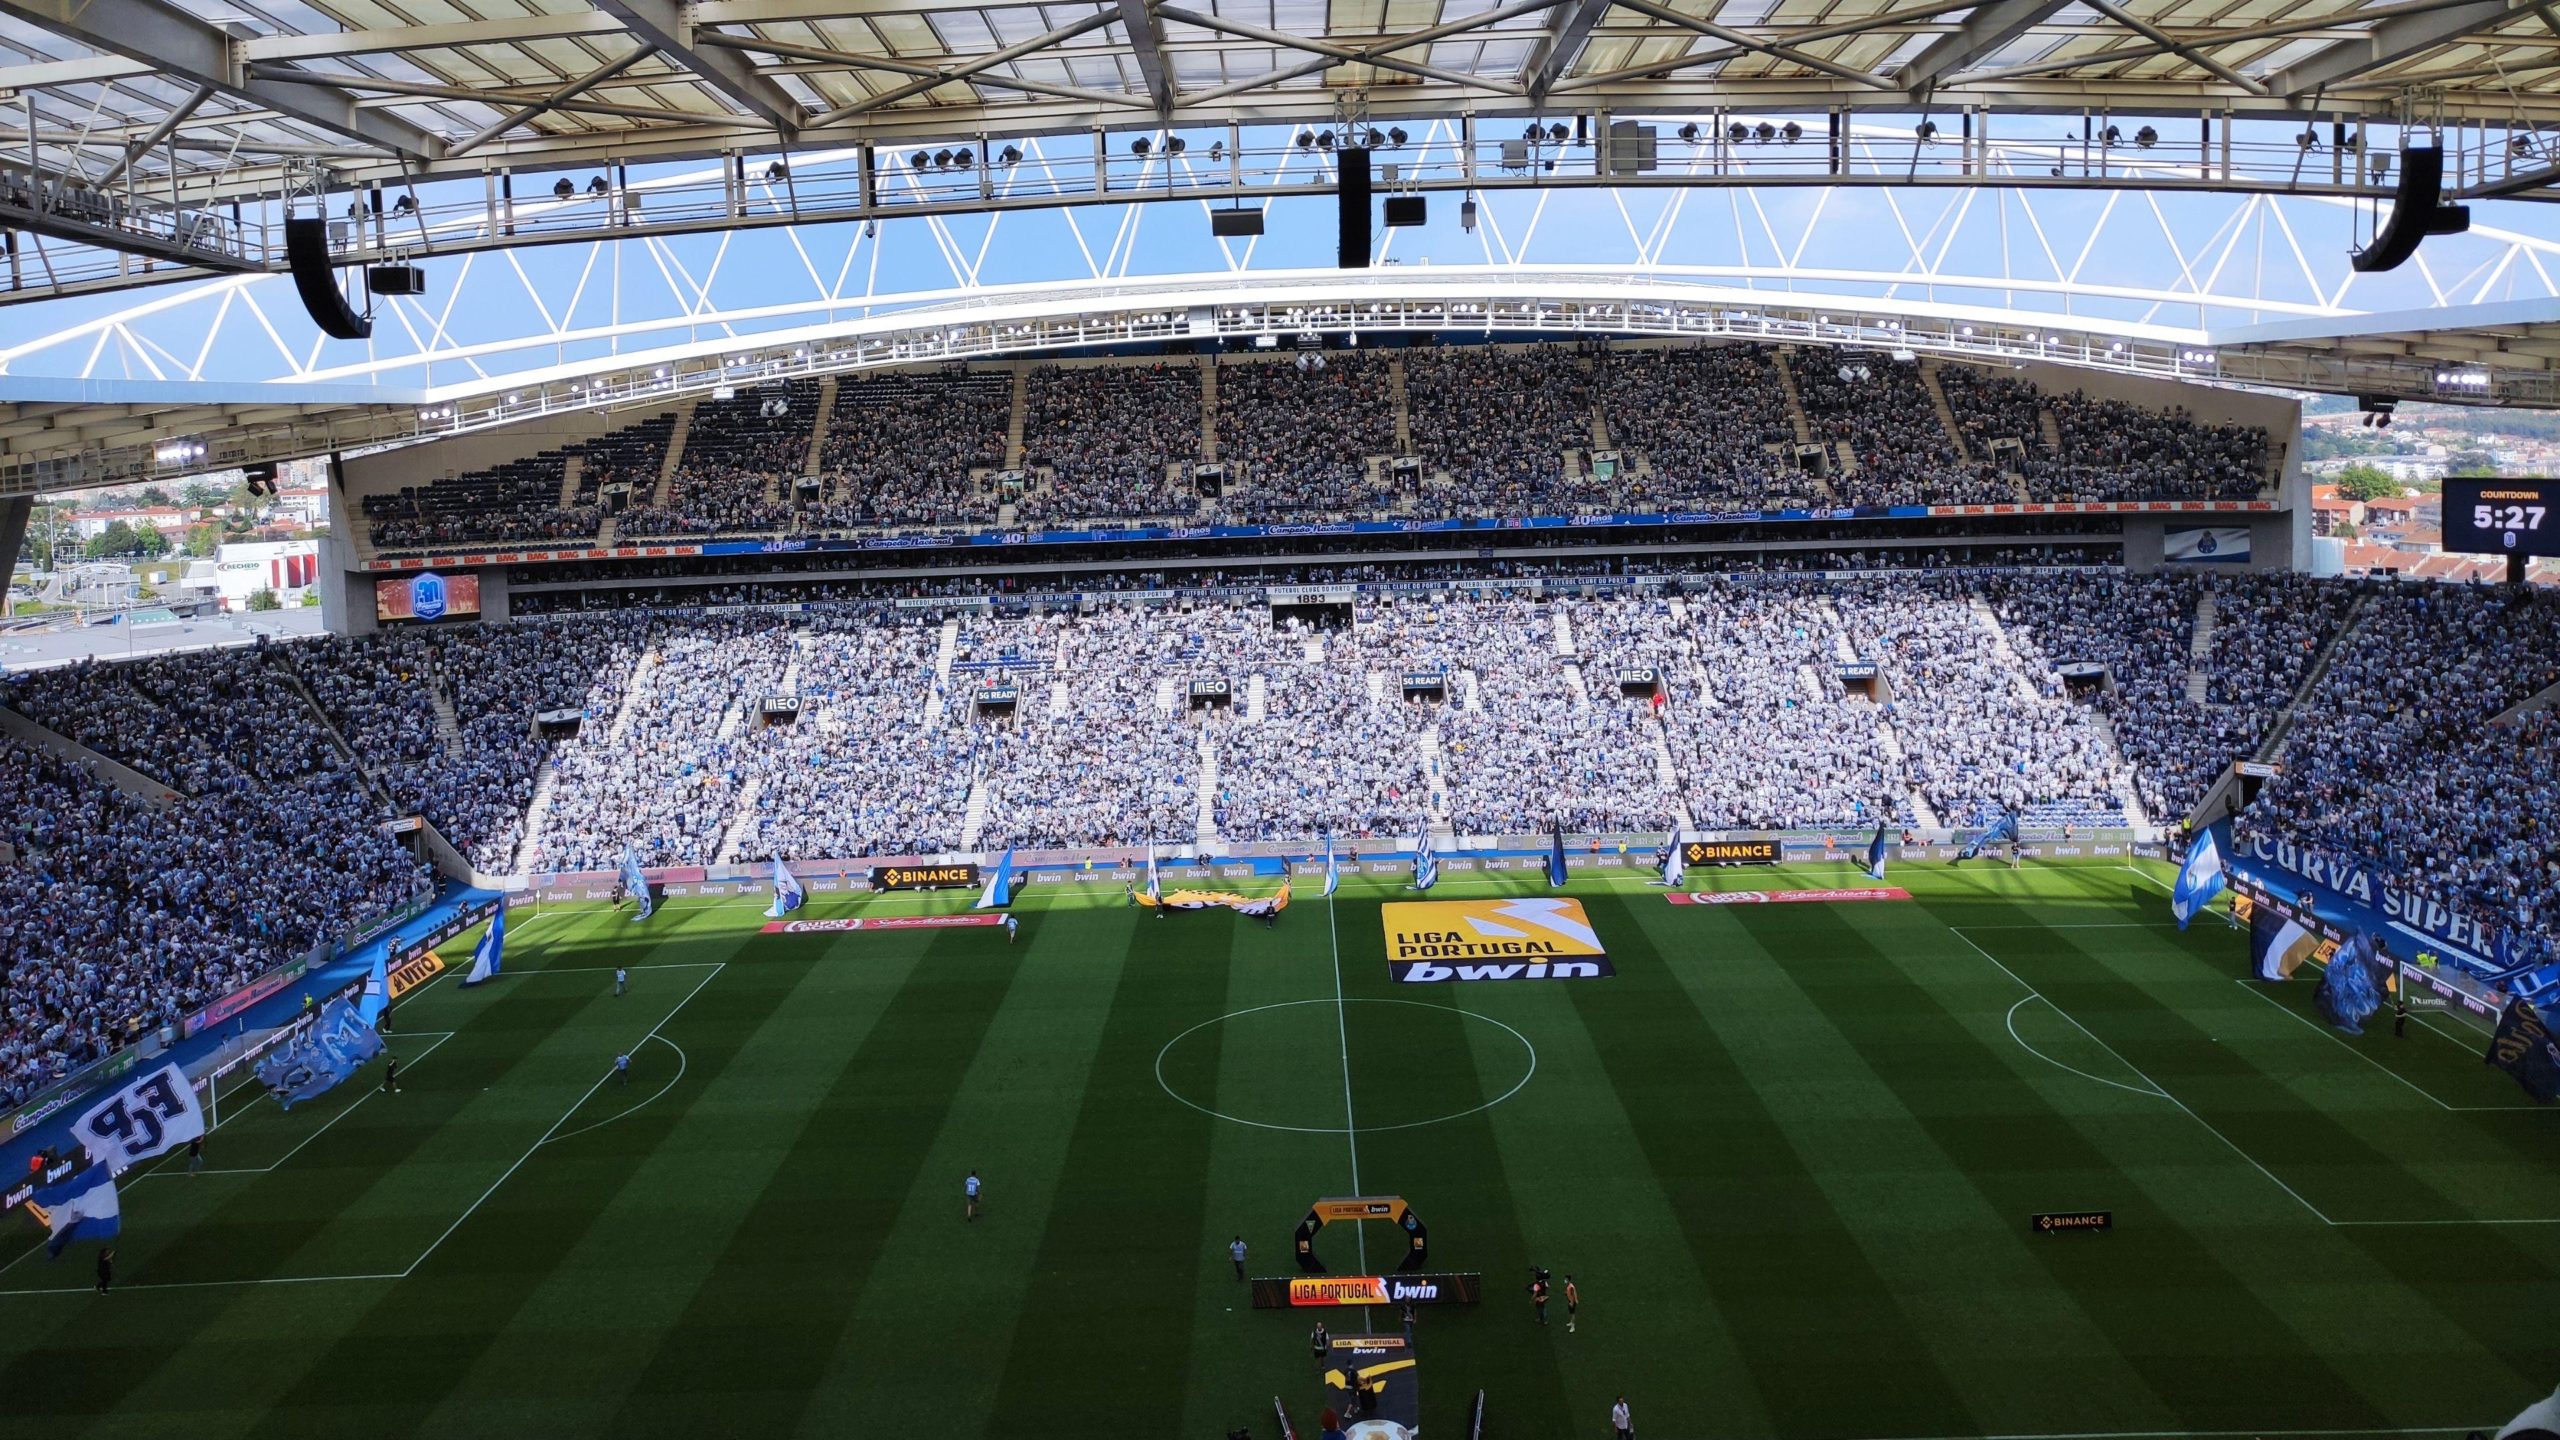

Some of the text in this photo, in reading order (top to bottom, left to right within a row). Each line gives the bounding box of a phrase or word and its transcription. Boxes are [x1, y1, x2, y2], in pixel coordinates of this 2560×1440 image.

[2480, 491, 2539, 500] COUNTDOWN
[1935, 506, 1956, 514] BMG
[1964, 505, 1985, 513] BMG
[1993, 504, 2015, 513] BMG
[2023, 504, 2045, 512] BMG
[2054, 503, 2076, 511] BMG
[2085, 503, 2107, 511] BMG
[2117, 502, 2139, 510] BMG
[2148, 502, 2171, 510] BMG
[2181, 502, 2205, 510] BMG
[2214, 502, 2238, 510] BMG
[2247, 502, 2271, 510] BMG
[1717, 510, 1761, 521] Nacional
[1811, 508, 1830, 518] 40
[2473, 505, 2546, 530] 5:27
[1402, 520, 1421, 530] 40
[1571, 515, 1590, 525] 40
[1312, 522, 1354, 533] Nacional
[909, 535, 953, 546] Nacional
[557, 551, 579, 559] BMG
[587, 550, 608, 558] BMG
[617, 548, 638, 556] BMG
[646, 547, 667, 555] BMG
[675, 546, 695, 554] BMG
[433, 557, 455, 567] BMG
[464, 555, 486, 565] BMG
[496, 554, 518, 563] BMG
[527, 553, 549, 561] BMG
[226, 562, 260, 570] RECHEIO
[369, 560, 392, 570] BMG
[401, 558, 423, 568] BMG
[1296, 594, 1326, 604] 1893
[1620, 669, 1653, 682] MEO
[1835, 666, 1876, 675] 5G READY
[1403, 676, 1442, 685] 5G READY
[1194, 681, 1227, 693] MEO
[978, 690, 1018, 700] 5G READY
[765, 697, 799, 710] MEO
[1706, 845, 1772, 858] BINANCE
[1901, 849, 1926, 858] bwin
[1977, 847, 2003, 857] bwin
[2055, 846, 2080, 855] bwin
[2094, 845, 2120, 854] bwin
[2133, 847, 2161, 858] bwin
[1635, 855, 1659, 864] bwin
[1787, 852, 1811, 861] bwin
[1825, 851, 1849, 860] bwin
[1448, 861, 1472, 870] bwin
[1485, 859, 1509, 868] bwin
[1523, 858, 1547, 867] bwin
[1598, 856, 1622, 866] bwin
[1223, 867, 1248, 876] bwin
[1298, 865, 1322, 874] bwin
[1373, 863, 1397, 872] bwin
[2254, 832, 2371, 903] CURVA
[902, 869, 968, 882] BINANCE
[1037, 873, 1061, 883] bwin
[1074, 872, 1099, 882] bwin
[1112, 871, 1136, 880] bwin
[1186, 868, 1211, 878] bwin
[700, 885, 725, 894] bwin
[738, 883, 762, 892] bwin
[812, 881, 837, 890] bwin
[2234, 880, 2248, 896] bwin
[548, 891, 573, 901] bwin
[586, 889, 611, 899] bwin
[662, 886, 687, 896] bwin
[508, 895, 534, 907] bwin
[2255, 890, 2270, 906] bwin
[485, 903, 499, 916] bwin
[2276, 901, 2292, 918] bwin
[380, 909, 408, 933] Nacional
[466, 912, 479, 927] bwin
[2299, 911, 2316, 929] bwin
[2383, 886, 2494, 959] SUPER
[447, 922, 461, 938] bwin
[2323, 925, 2341, 942] bwin
[428, 933, 442, 949] bwin
[1396, 931, 1464, 945] LIGA
[408, 945, 422, 961] bwin
[1399, 941, 1564, 957] PORTUGAL
[2375, 950, 2394, 968] bwin
[387, 957, 402, 974] bwin
[1402, 957, 1599, 982] bwin
[398, 956, 437, 990] VITO
[2402, 965, 2422, 982] bwin
[344, 983, 360, 999] bwin
[2432, 980, 2453, 998] bwin
[2463, 995, 2485, 1014] bwin
[297, 1012, 314, 1029] bwin
[11, 1101, 62, 1134] Campeão
[47, 1159, 72, 1184] bwin
[6, 1183, 34, 1210] bwin
[2054, 1215, 2104, 1226] BINANCE
[1294, 1280, 1438, 1300] LIGA PORTUGAL bwin
[1352, 1346, 1387, 1354] bwin
